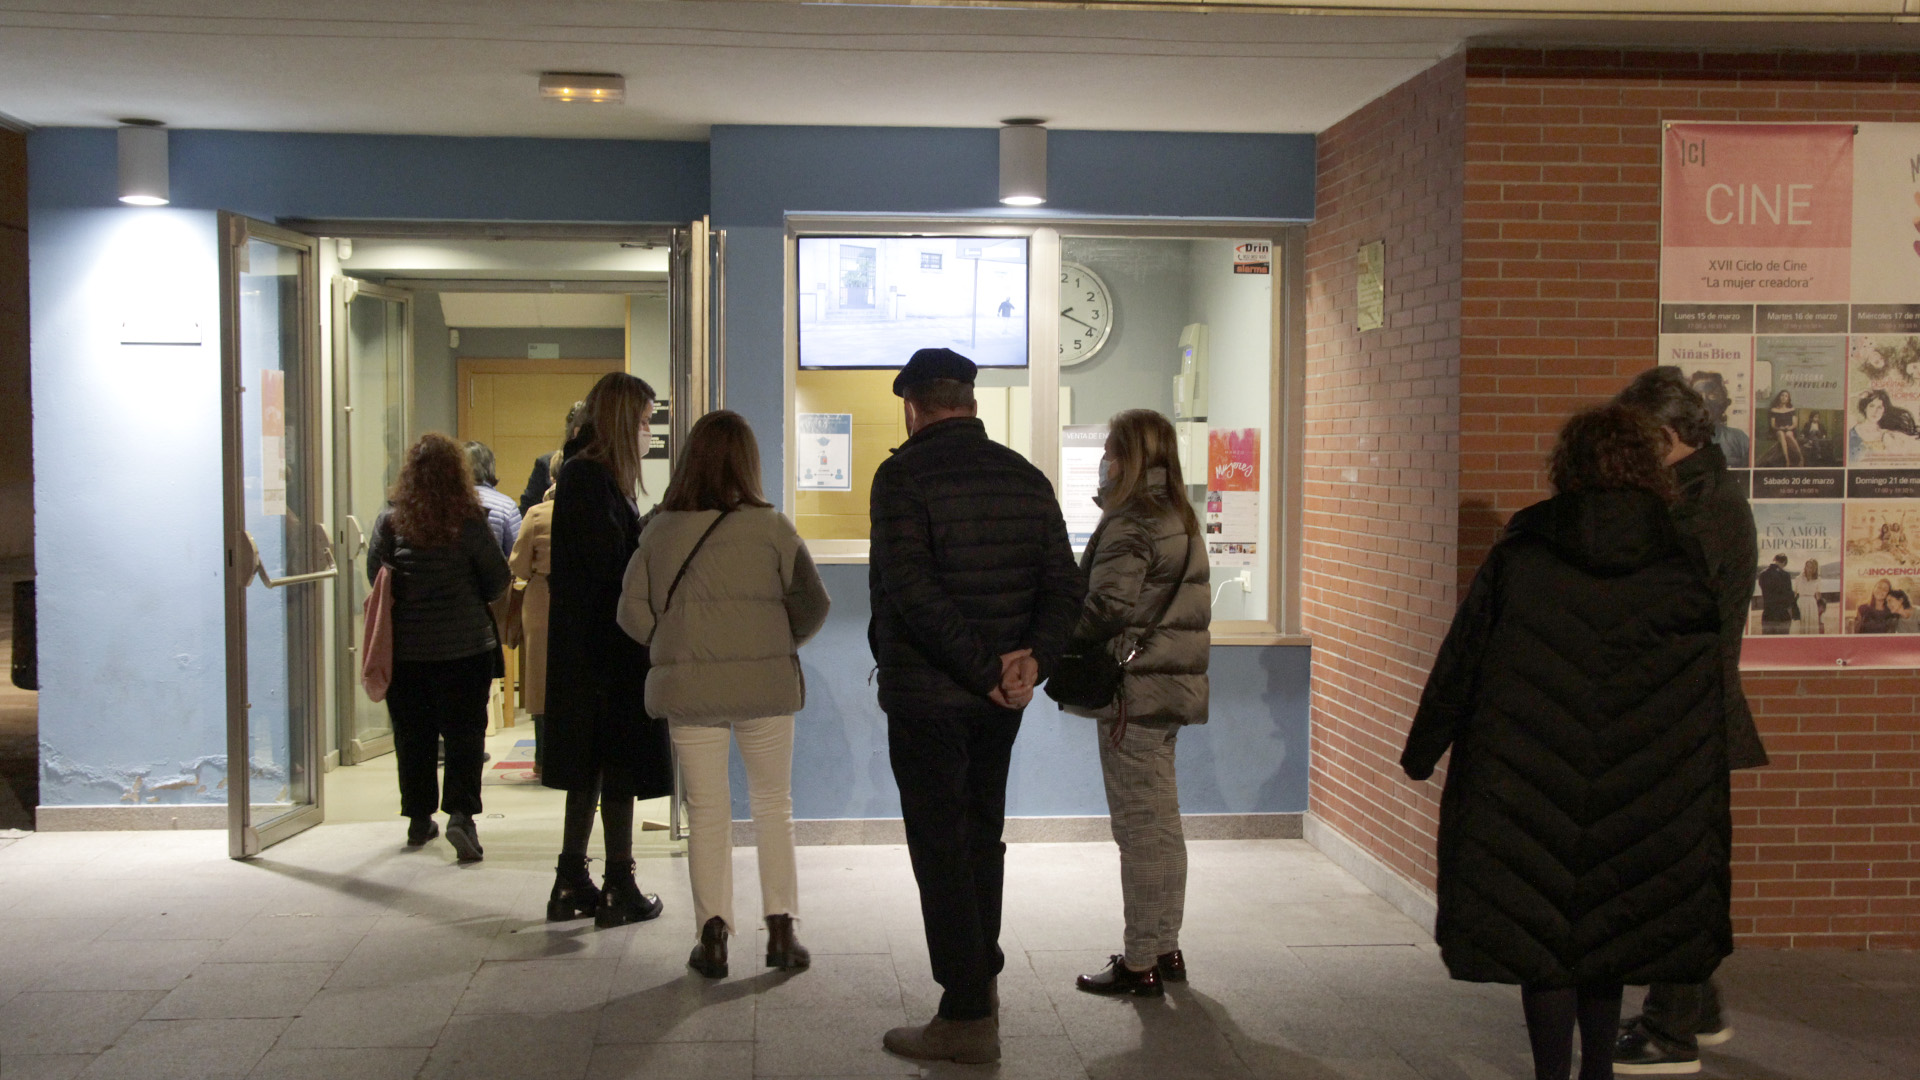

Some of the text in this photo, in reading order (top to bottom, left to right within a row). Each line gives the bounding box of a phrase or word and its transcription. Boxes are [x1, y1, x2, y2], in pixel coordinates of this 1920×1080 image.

[1705, 183, 1814, 225] CINE
[1245, 243, 1269, 253] Drin
[1708, 259, 1808, 272] XVII Ciclo de Cine
[1076, 278, 1080, 288] 1
[1723, 277, 1755, 290] mujer
[1086, 292, 1095, 302] 2
[1091, 310, 1100, 320] 3
[1674, 312, 1695, 320] Lunes
[1697, 312, 1706, 320] 15
[1707, 312, 1717, 320] de
[1767, 312, 1793, 320] Martes
[1795, 312, 1803, 320] 16
[1804, 312, 1814, 320] de
[1894, 312, 1903, 320] 17
[1904, 311, 1914, 320] de
[1085, 328, 1093, 338] 4
[1074, 340, 1082, 350] 5
[1698, 340, 1713, 348] Las
[1671, 348, 1741, 360] Niñas Bien
[1066, 431, 1087, 440] VENTA
[1089, 431, 1097, 440] DE
[1763, 476, 1790, 485] Sábado
[1791, 477, 1801, 485] 20
[1802, 477, 1811, 485] de
[1855, 476, 1888, 486] Domingo
[1888, 476, 1898, 485] 21
[1899, 476, 1909, 485] de
[1766, 526, 1827, 537] UN AMOR
[1761, 538, 1832, 550] IMPOSIBLE
